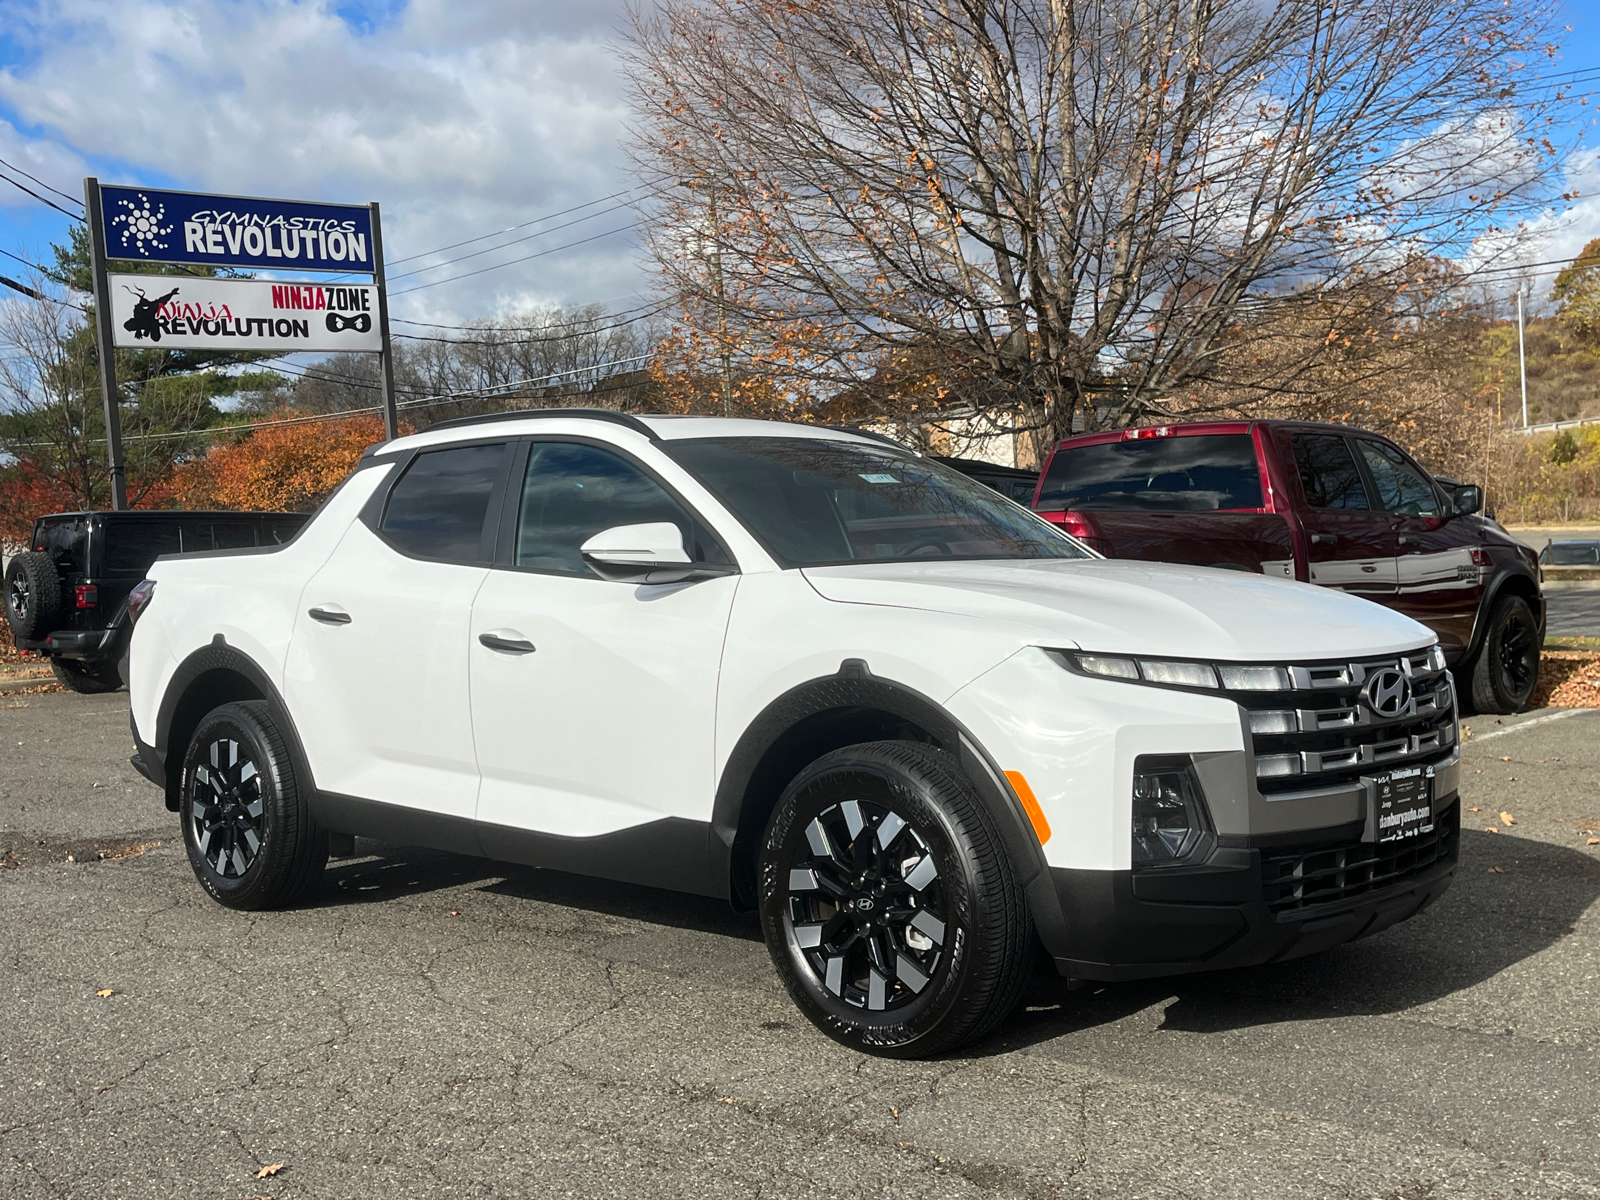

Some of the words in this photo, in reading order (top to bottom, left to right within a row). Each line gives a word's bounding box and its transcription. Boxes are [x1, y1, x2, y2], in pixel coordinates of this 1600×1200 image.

[191, 211, 356, 233] GYMNASTICS
[184, 221, 367, 262] REVOLUTION
[157, 316, 309, 338] REVOLUTION
[1379, 806, 1430, 829] danburyauto.com
